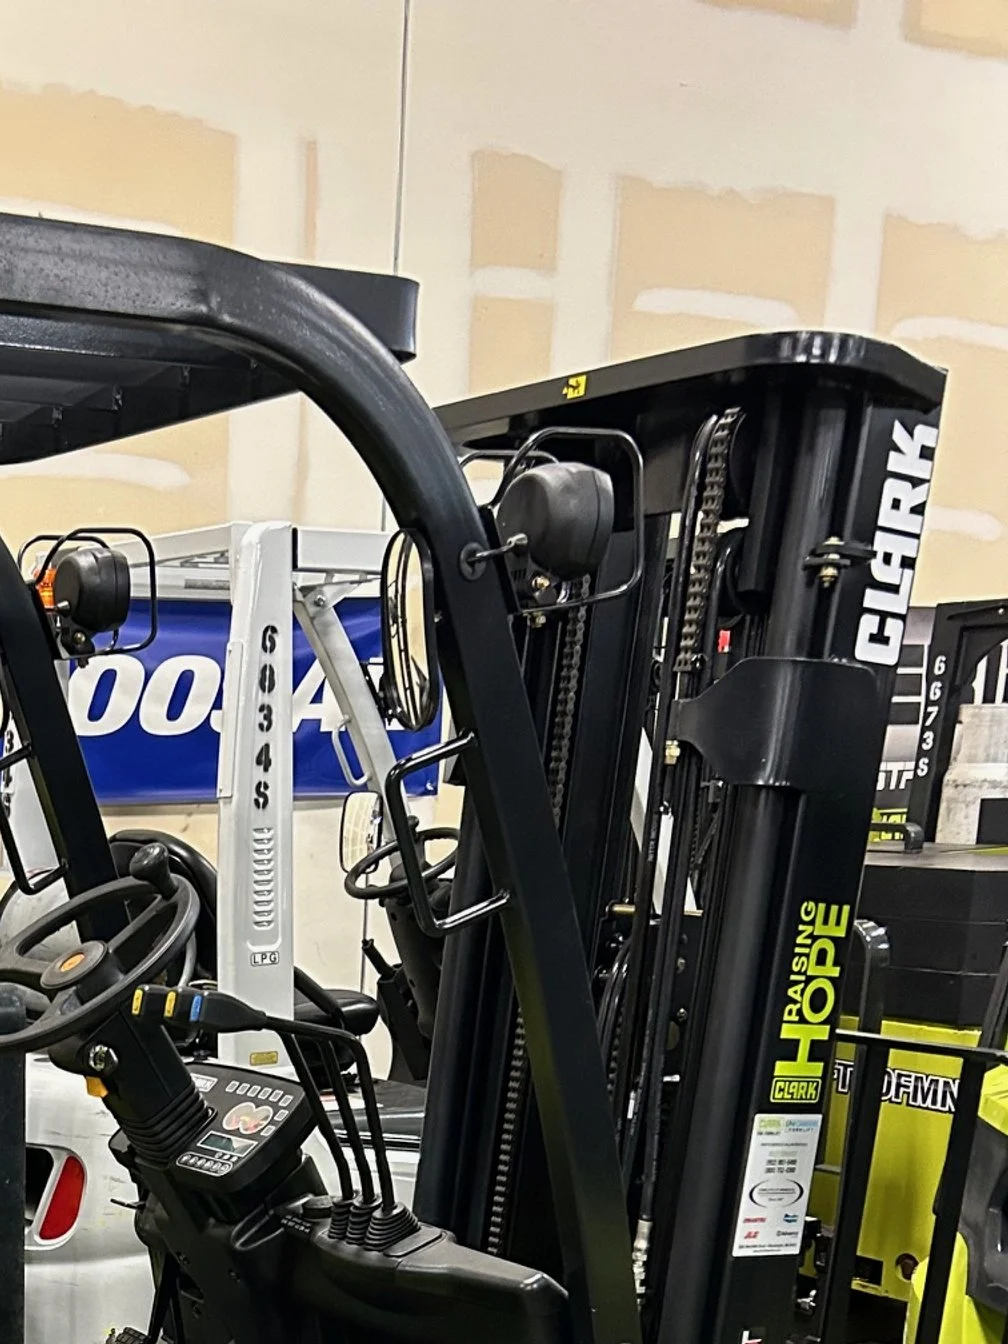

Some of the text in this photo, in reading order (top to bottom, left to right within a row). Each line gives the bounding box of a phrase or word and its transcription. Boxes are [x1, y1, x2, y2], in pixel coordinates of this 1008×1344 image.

[854, 419, 940, 667] CLARK
[252, 624, 279, 811] 6834S
[917, 655, 946, 777] 6673S
[253, 953, 277, 964] LPG
[773, 902, 850, 1077] HOPE
[783, 900, 816, 1022] RAISING
[774, 1081, 818, 1100] CLARK
